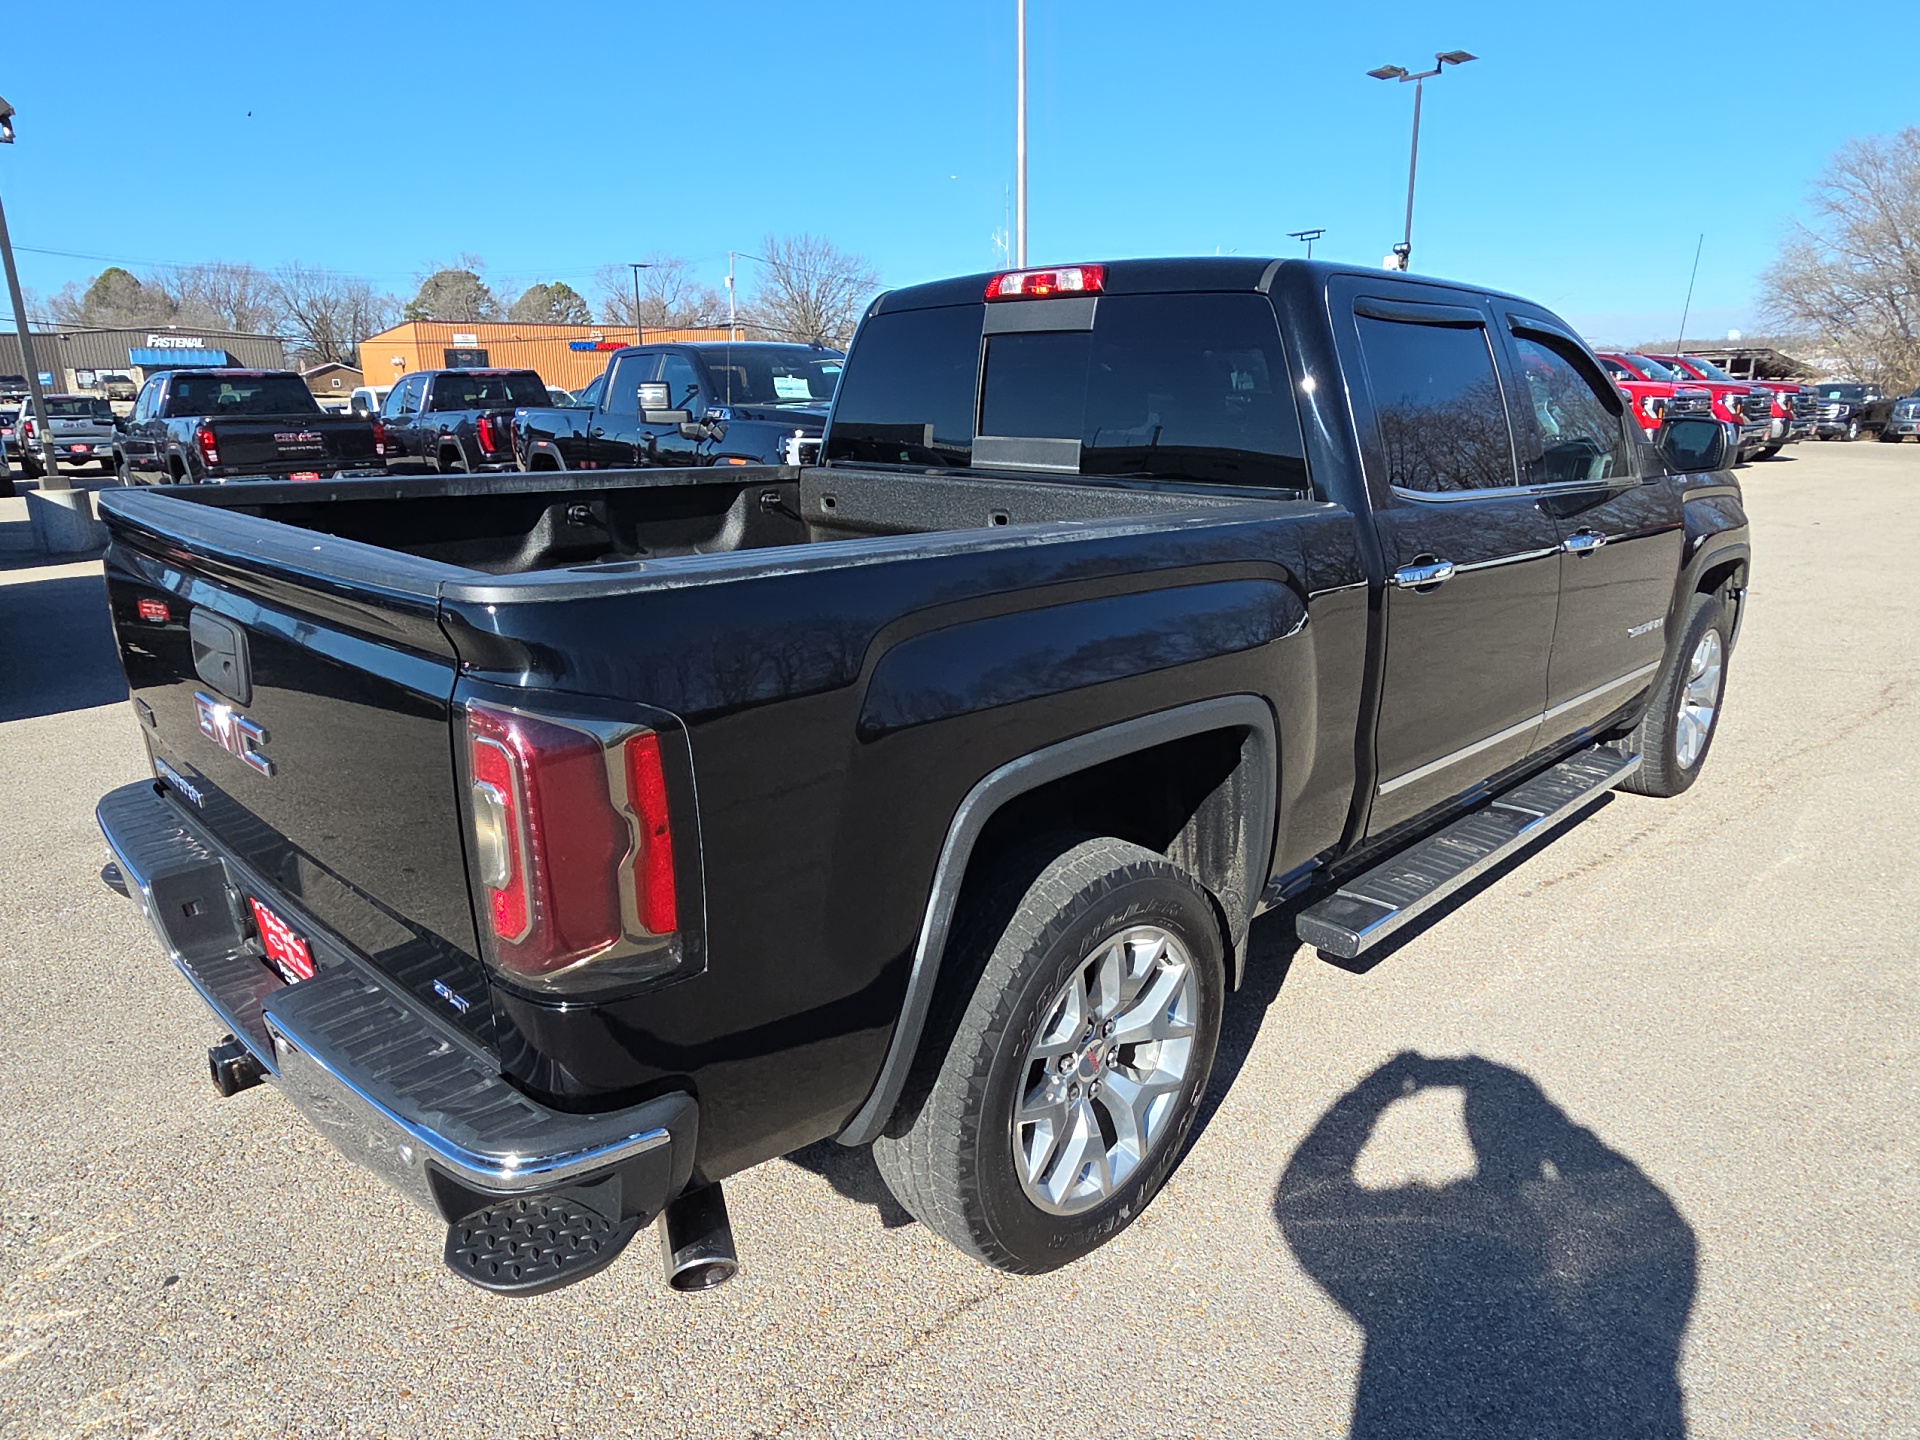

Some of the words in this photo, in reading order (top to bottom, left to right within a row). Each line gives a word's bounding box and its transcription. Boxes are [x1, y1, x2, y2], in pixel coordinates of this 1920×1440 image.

[147, 334, 205, 348] FASTENAL
[274, 432, 322, 442] GMC
[193, 691, 277, 778] GMC
[433, 978, 471, 1014] SLT
